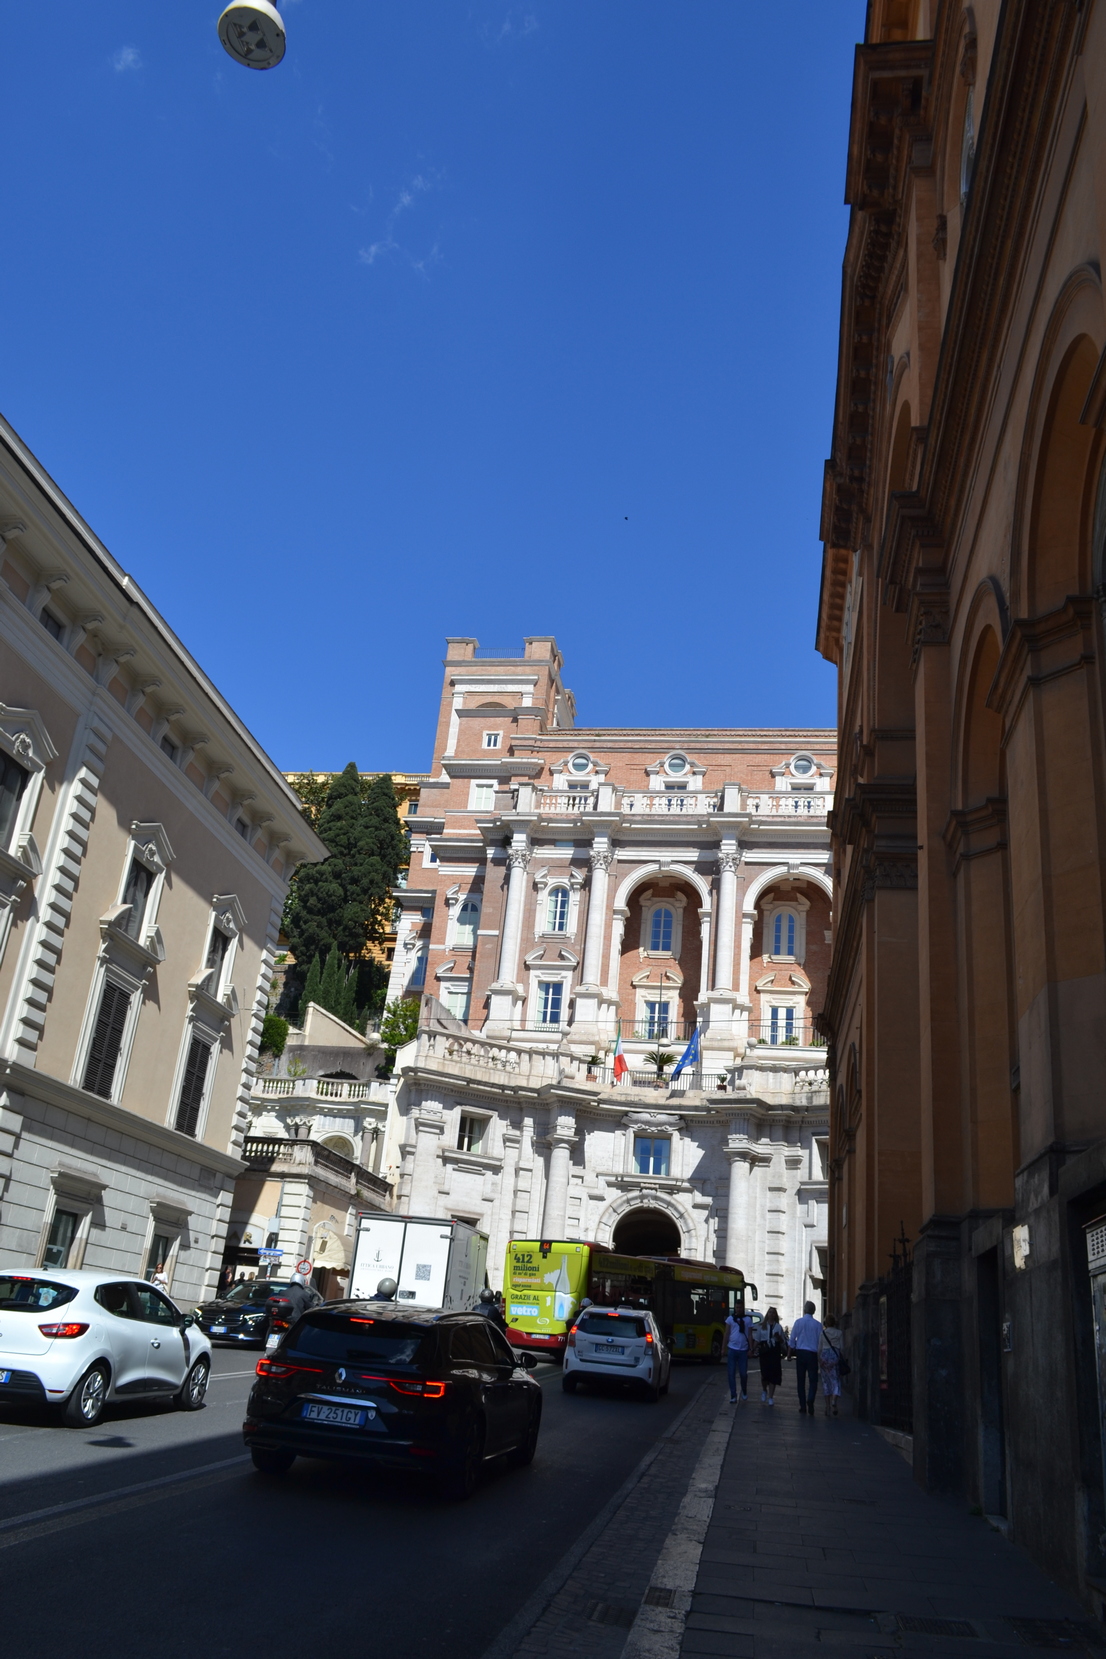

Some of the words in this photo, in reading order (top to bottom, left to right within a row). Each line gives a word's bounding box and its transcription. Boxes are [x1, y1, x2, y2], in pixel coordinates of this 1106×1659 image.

[514, 1253, 532, 1263] 412
[513, 1264, 540, 1272] milioni
[510, 1293, 531, 1301] GRAZIE
[510, 1306, 538, 1316] vetro
